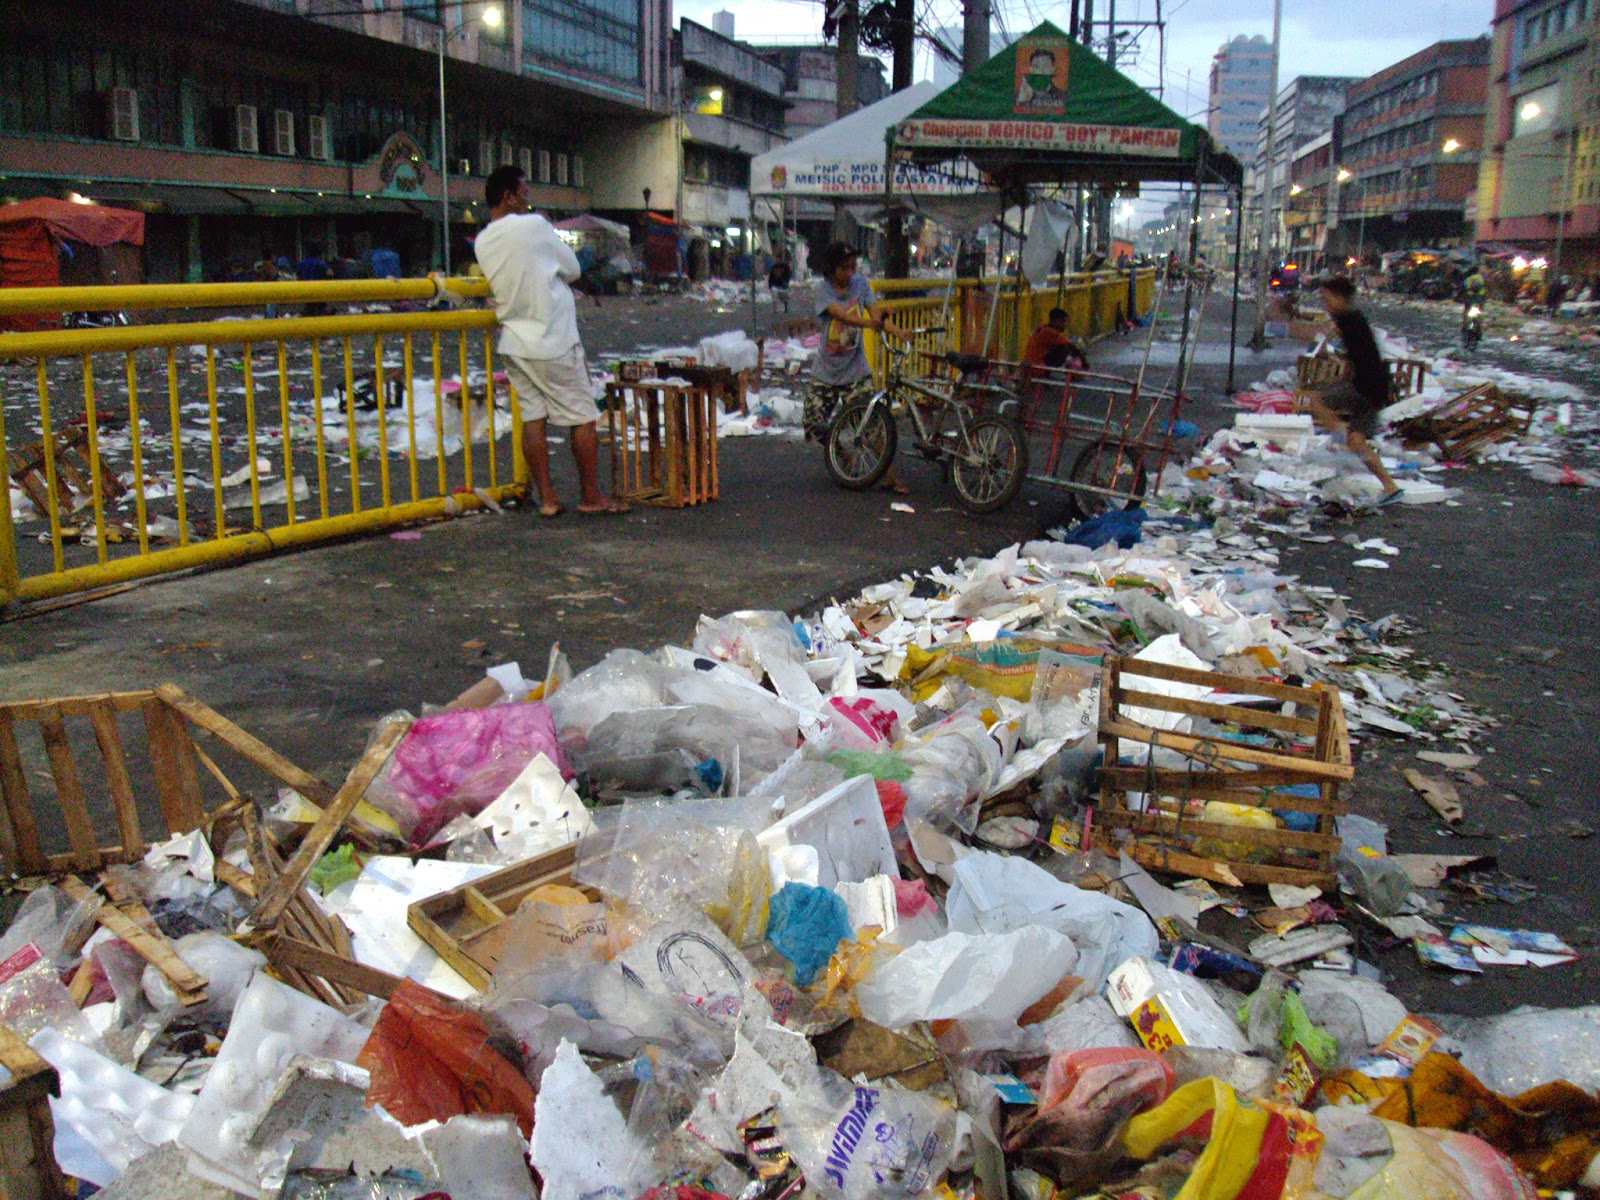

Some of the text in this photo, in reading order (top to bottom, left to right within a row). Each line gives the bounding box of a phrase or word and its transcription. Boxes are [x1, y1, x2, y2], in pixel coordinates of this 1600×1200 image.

[988, 121, 1054, 140] MONICO
[1110, 127, 1179, 147] PANGAN
[813, 164, 839, 174] PNP
[851, 163, 878, 173] MPD
[795, 174, 846, 185] MEISIC
[851, 175, 904, 185] POLIE
